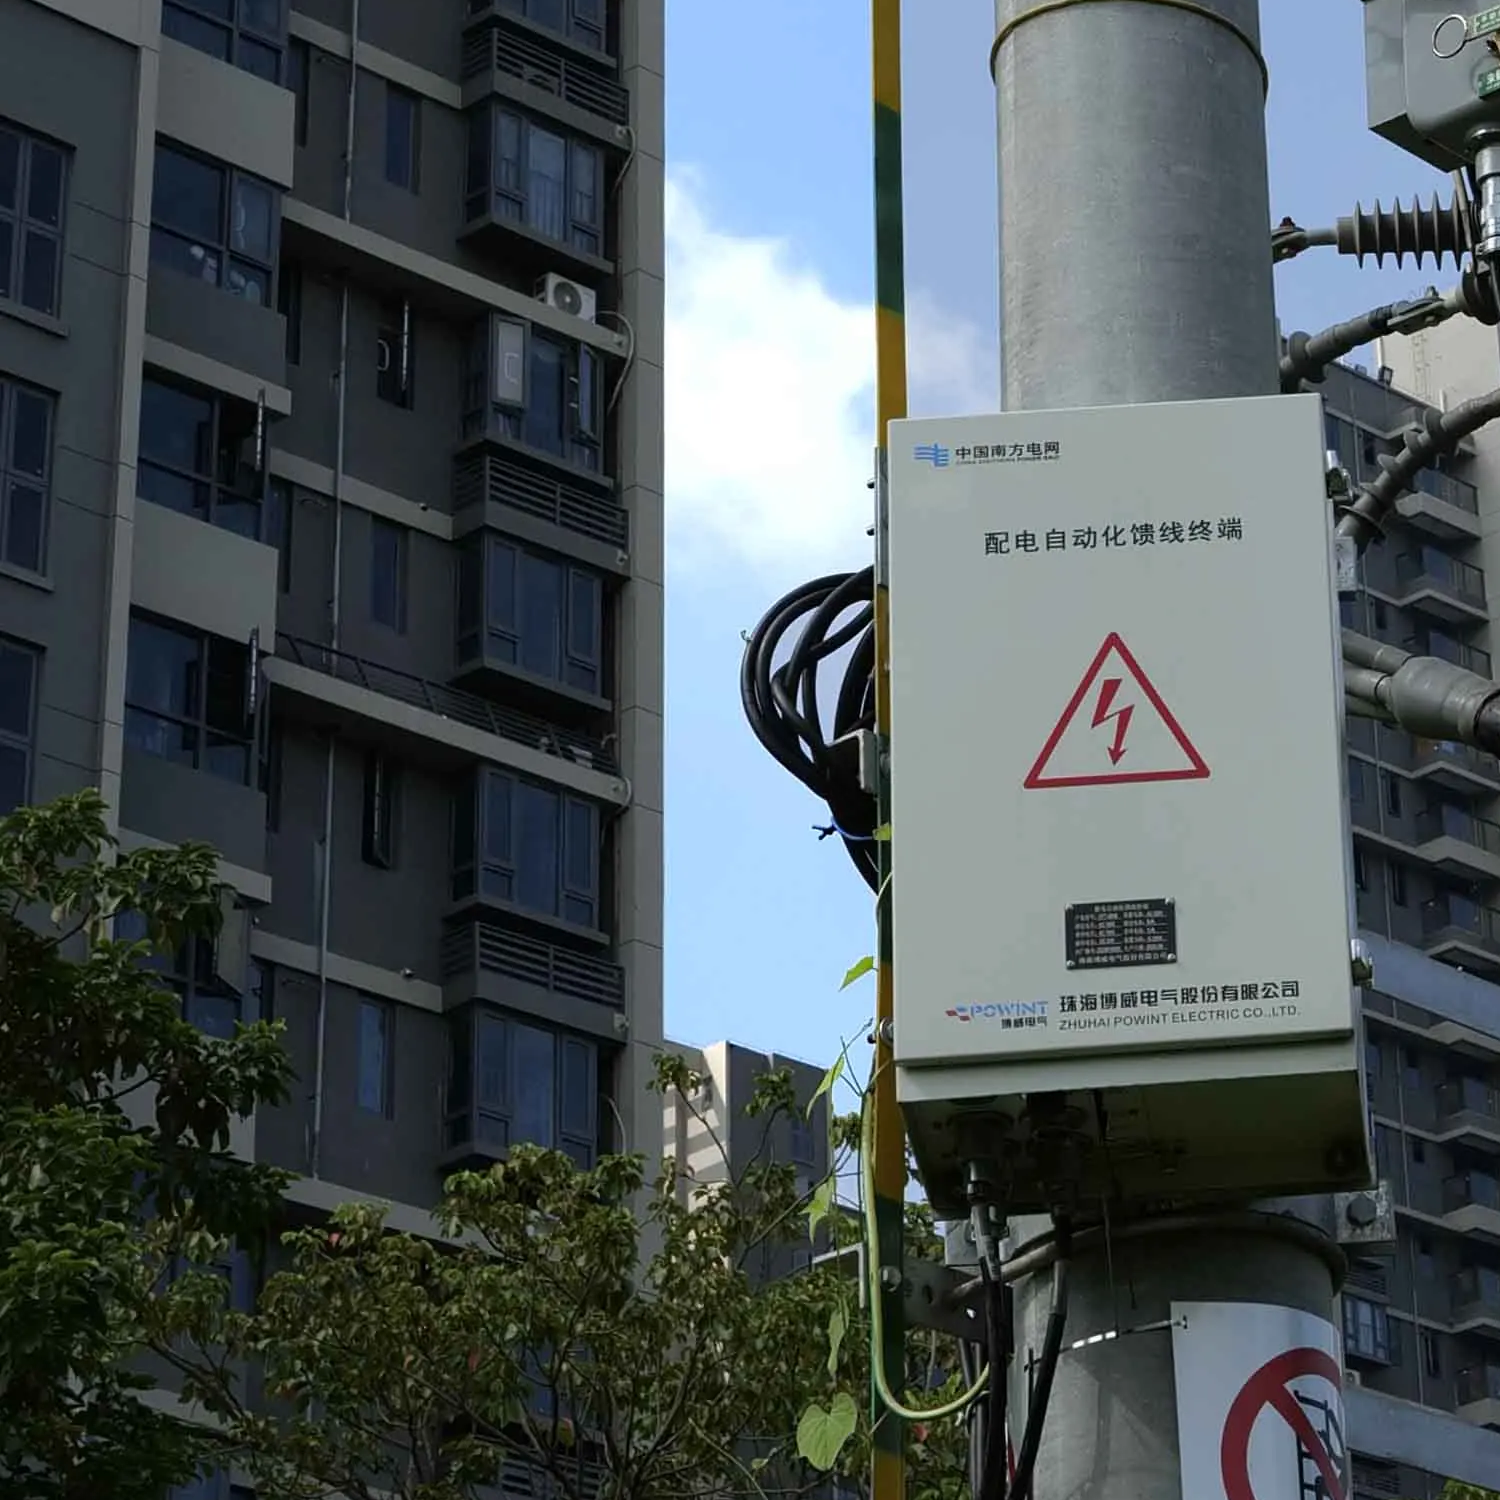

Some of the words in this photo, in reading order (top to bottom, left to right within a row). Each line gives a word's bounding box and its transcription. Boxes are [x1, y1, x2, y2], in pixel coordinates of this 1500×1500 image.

[956, 441, 1060, 460] 中国南方电网
[984, 516, 1244, 555] 配电自动化馈线终端
[1059, 980, 1300, 1013] 珠海博威电气股份有限公司
[970, 1001, 1048, 1018] POWINT
[1059, 1016, 1110, 1031] ZHUHAI
[1113, 1012, 1169, 1027] POWINT
[1172, 1007, 1240, 1024] ELECTRIC
[1001, 1015, 1048, 1029] 博威电气
